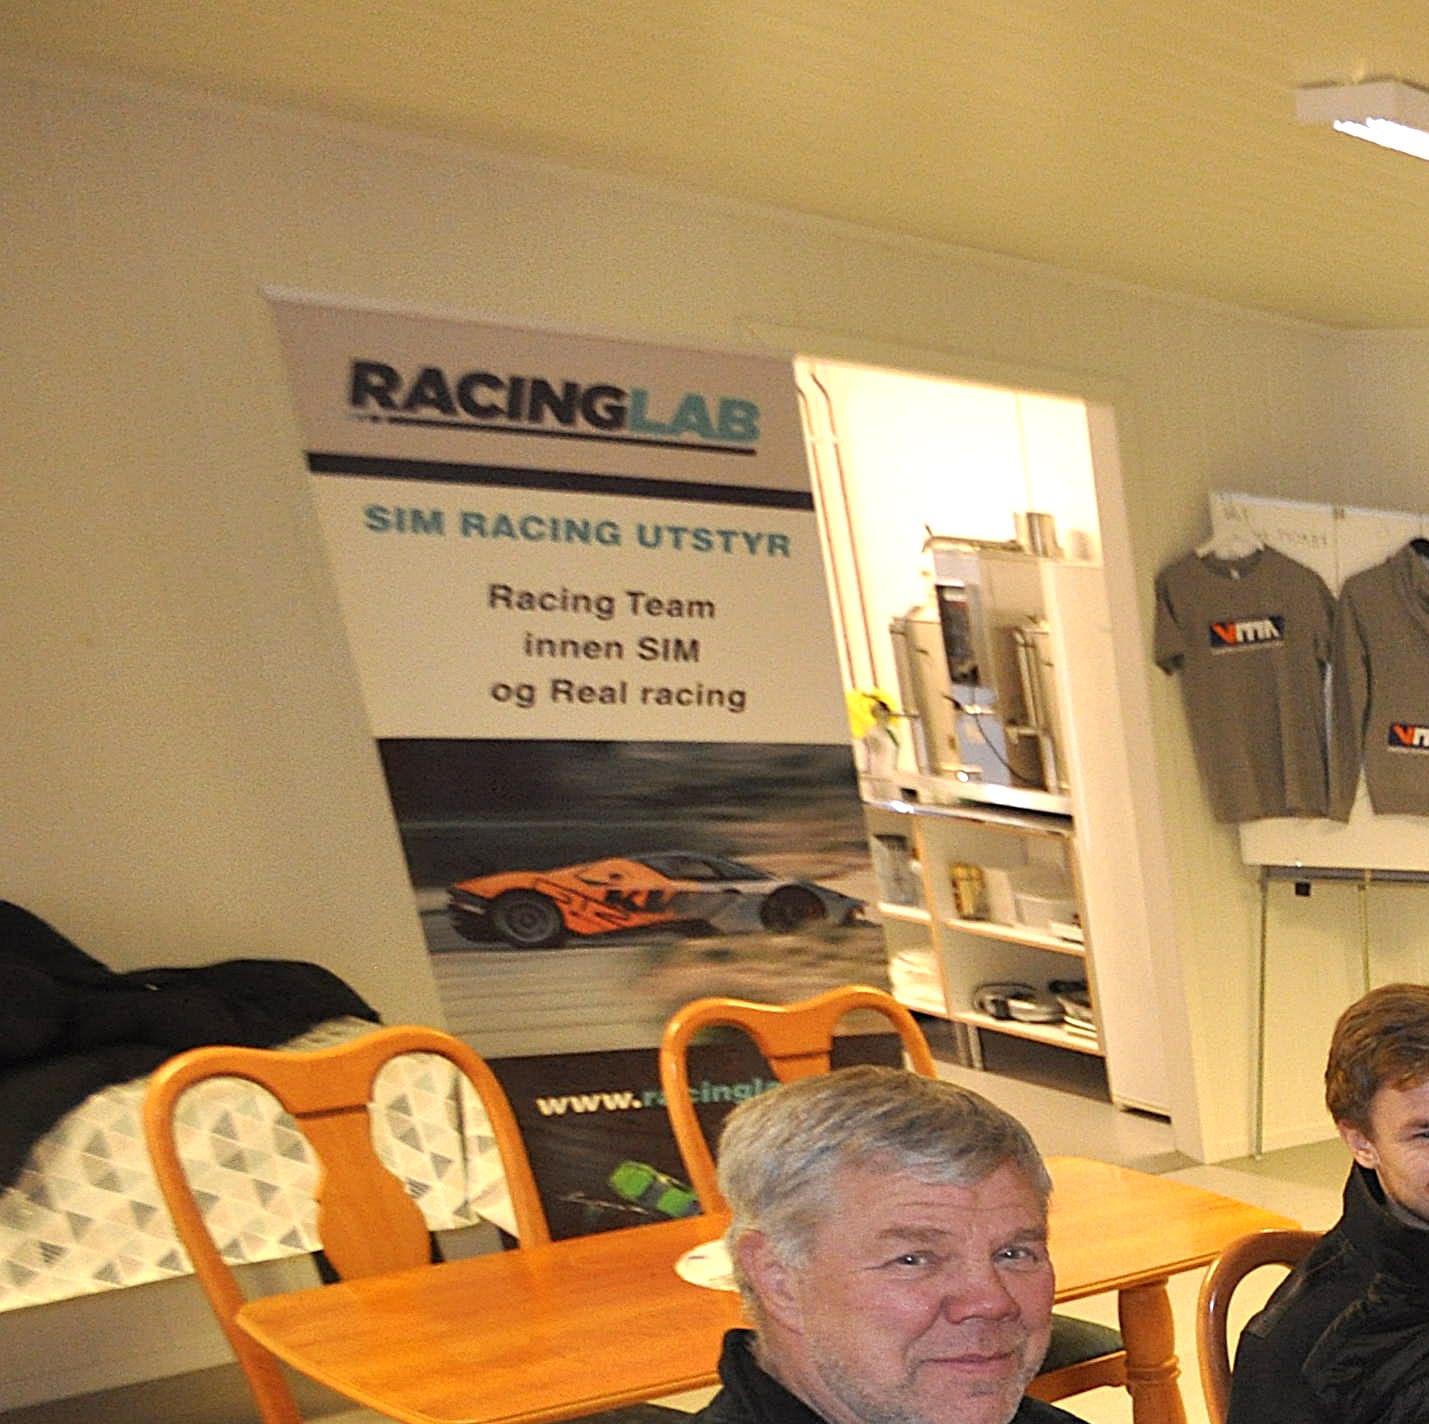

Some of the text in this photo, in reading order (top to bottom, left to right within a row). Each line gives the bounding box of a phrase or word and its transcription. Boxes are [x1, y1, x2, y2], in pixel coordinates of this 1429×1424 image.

[351, 361, 760, 442] RACINGLAB
[364, 504, 791, 557] SIM RACING UTSTYR
[488, 584, 716, 620] Racing Team
[523, 631, 699, 662] innen SIM
[490, 678, 747, 713] og Real racing
